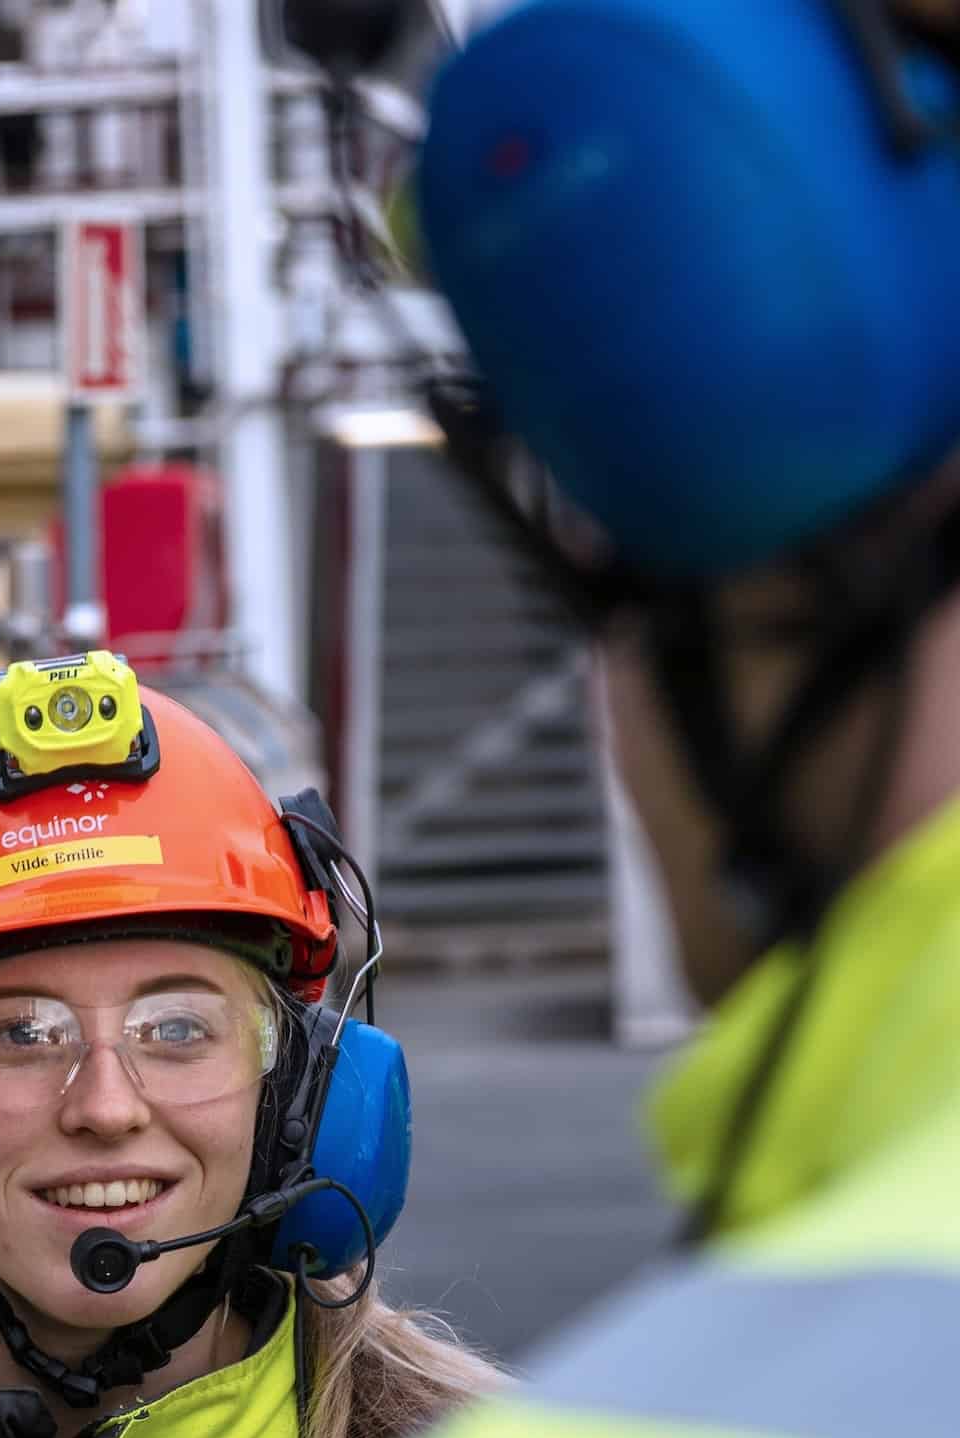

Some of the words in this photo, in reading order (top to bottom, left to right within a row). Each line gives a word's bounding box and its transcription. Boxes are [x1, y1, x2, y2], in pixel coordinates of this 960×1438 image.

[49, 669, 77, 681] PELI
[1, 814, 108, 848] equinor
[11, 857, 49, 873] Vilde
[55, 847, 104, 865] Emilie
